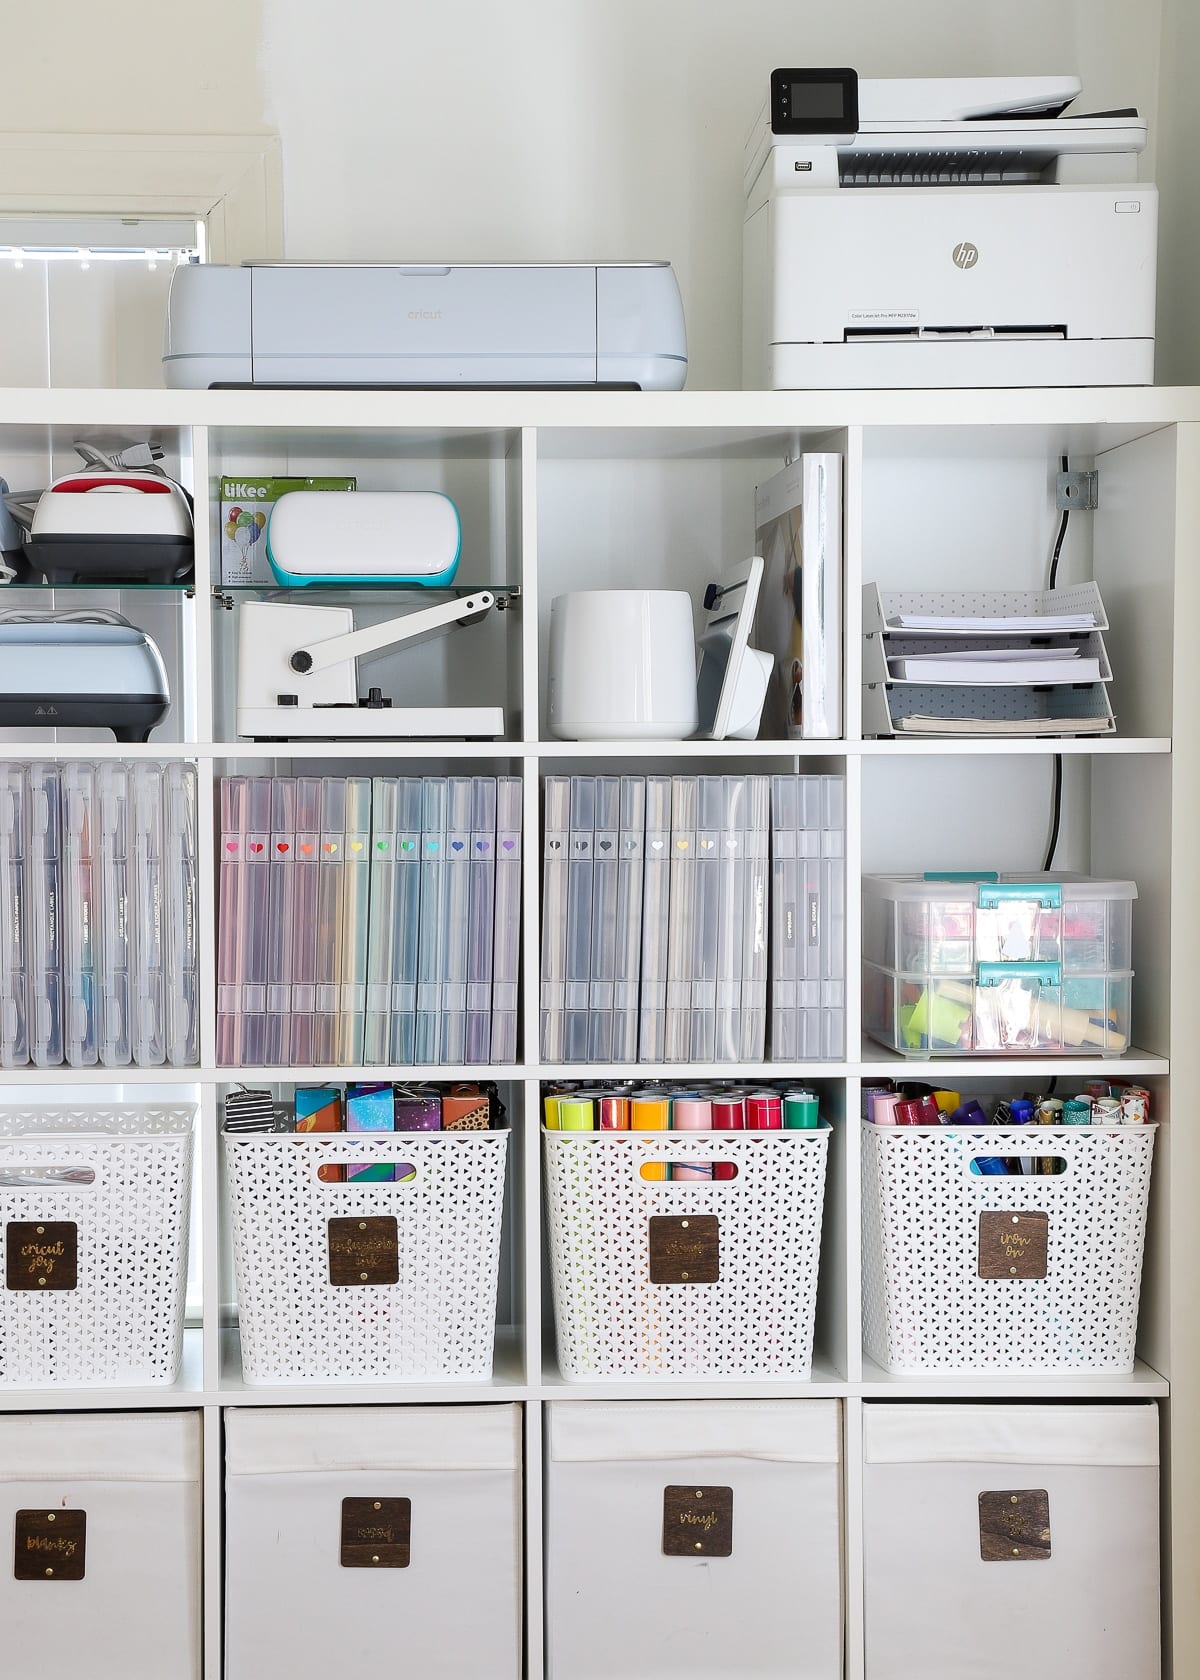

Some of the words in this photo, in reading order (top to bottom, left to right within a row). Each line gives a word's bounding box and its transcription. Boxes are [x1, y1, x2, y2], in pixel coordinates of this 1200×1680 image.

[954, 242, 977, 270] hp
[407, 309, 443, 320] cricut
[1000, 1232, 1031, 1246] iron
[21, 1240, 65, 1256] cricut
[1005, 1245, 1025, 1258] on
[28, 1255, 56, 1274] joy
[680, 1509, 718, 1531] vinyl
